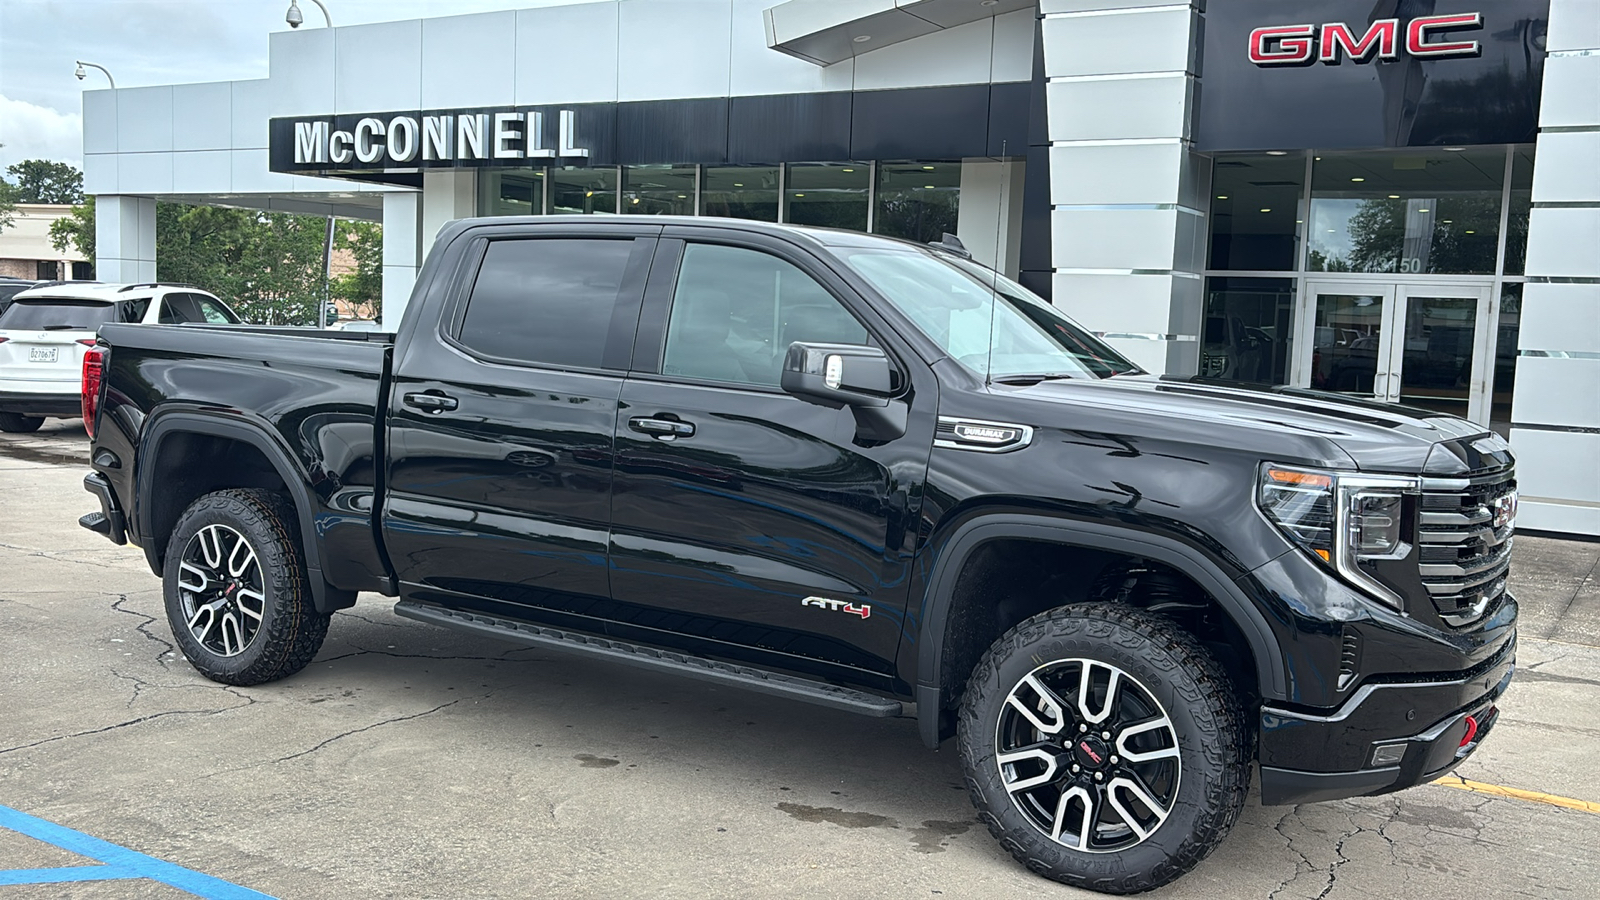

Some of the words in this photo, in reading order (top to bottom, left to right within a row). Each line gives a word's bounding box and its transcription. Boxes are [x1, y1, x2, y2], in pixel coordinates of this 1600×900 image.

[1248, 12, 1481, 64] GMC
[294, 110, 589, 164] McCONNELL
[1379, 257, 1421, 273] 3150
[963, 426, 1005, 438] DURAMAX
[801, 595, 872, 620] AT4
[1080, 741, 1102, 764] GMC
